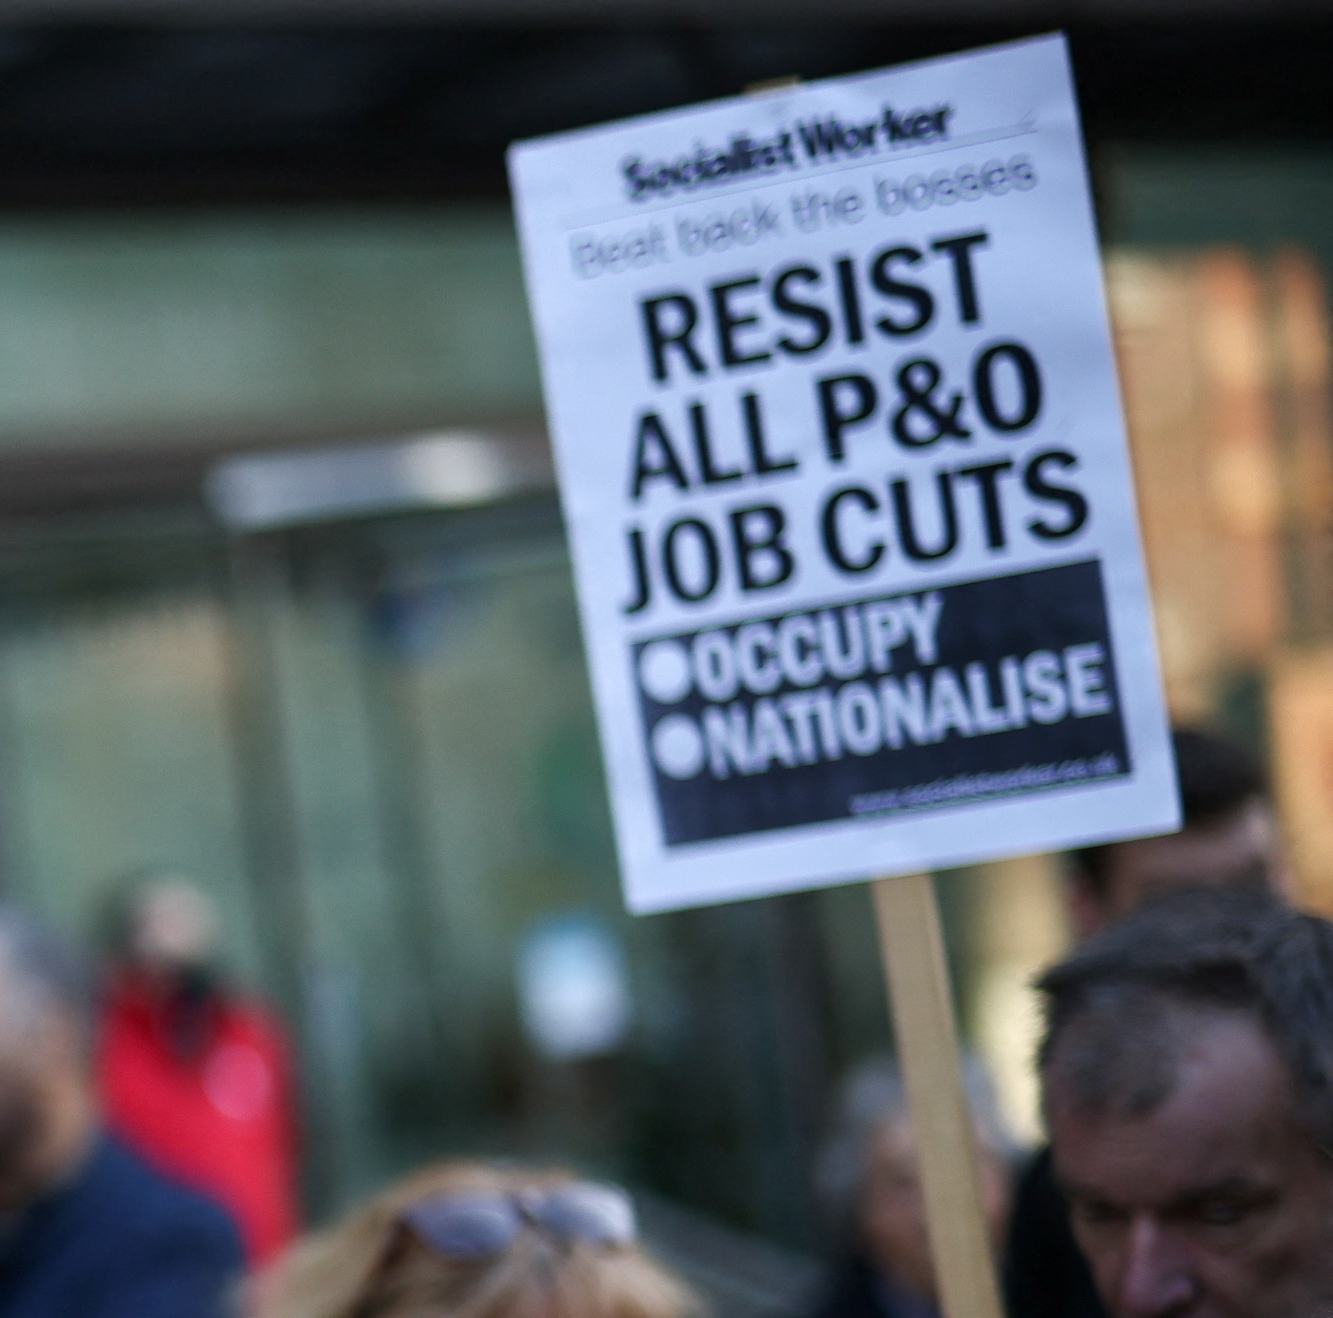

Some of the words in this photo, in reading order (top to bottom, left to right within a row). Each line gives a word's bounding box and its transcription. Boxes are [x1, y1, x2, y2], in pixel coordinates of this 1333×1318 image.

[619, 128, 794, 202] Socialist
[797, 100, 955, 166] Worker
[640, 224, 990, 383] RESIST
[627, 390, 798, 502] ALL
[817, 342, 1045, 464] P&O
[622, 502, 796, 615] JOB
[820, 449, 1091, 575] CUTS
[689, 590, 946, 701] OCCUPY
[701, 640, 1113, 781] NATIONALISE
